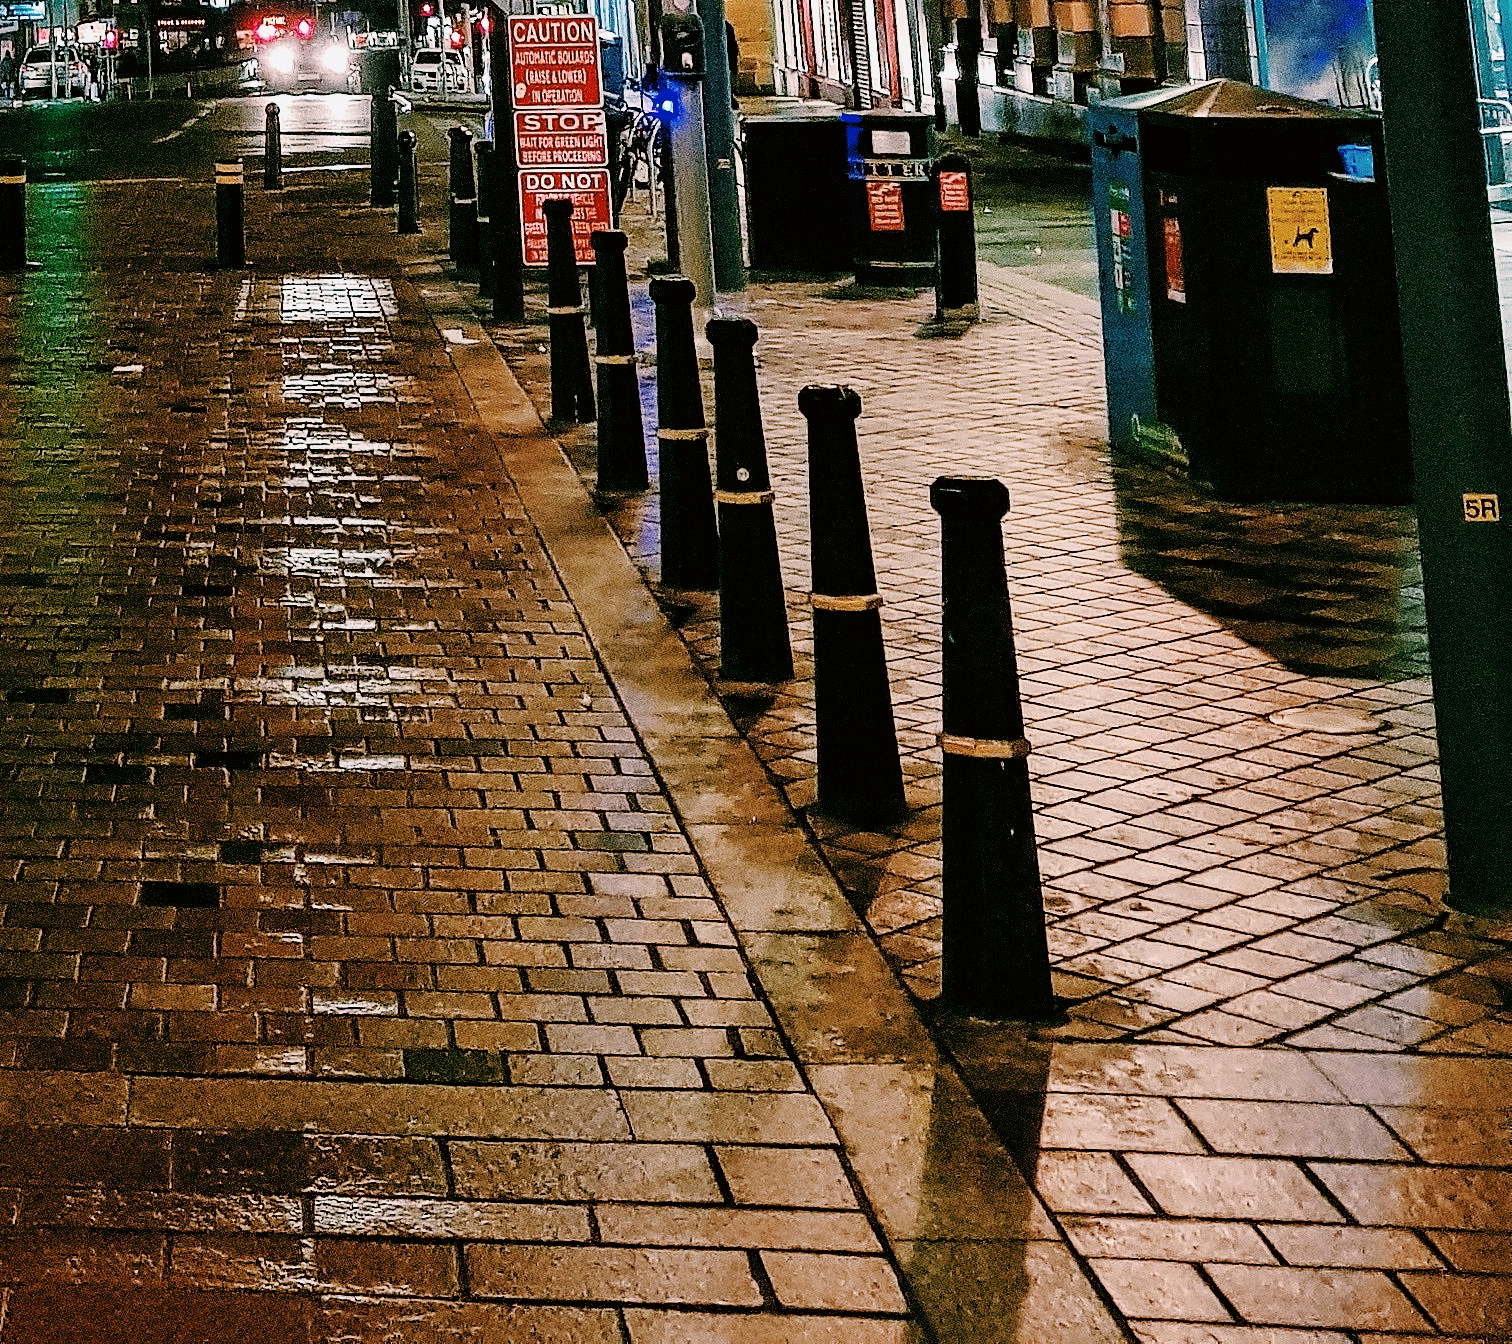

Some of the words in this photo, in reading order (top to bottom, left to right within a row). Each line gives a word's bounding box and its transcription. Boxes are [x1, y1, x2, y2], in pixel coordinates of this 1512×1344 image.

[513, 21, 594, 43] CAUTION
[515, 51, 556, 65] AUTOMATIC
[557, 50, 595, 65] BOLLARDS
[531, 90, 541, 103] IN
[542, 88, 584, 103] OPERATION
[524, 114, 598, 130] STOP
[519, 136, 538, 149] WAIT
[538, 136, 554, 148] FOR
[554, 136, 581, 148] GREEN
[582, 135, 603, 148] LIGHT
[522, 151, 552, 163] BEFORE
[553, 150, 602, 163] PROCEEDING
[854, 161, 927, 178] ITTER
[526, 174, 555, 190] DO
[561, 173, 602, 189] NOT
[1465, 498, 1497, 519] 5R
